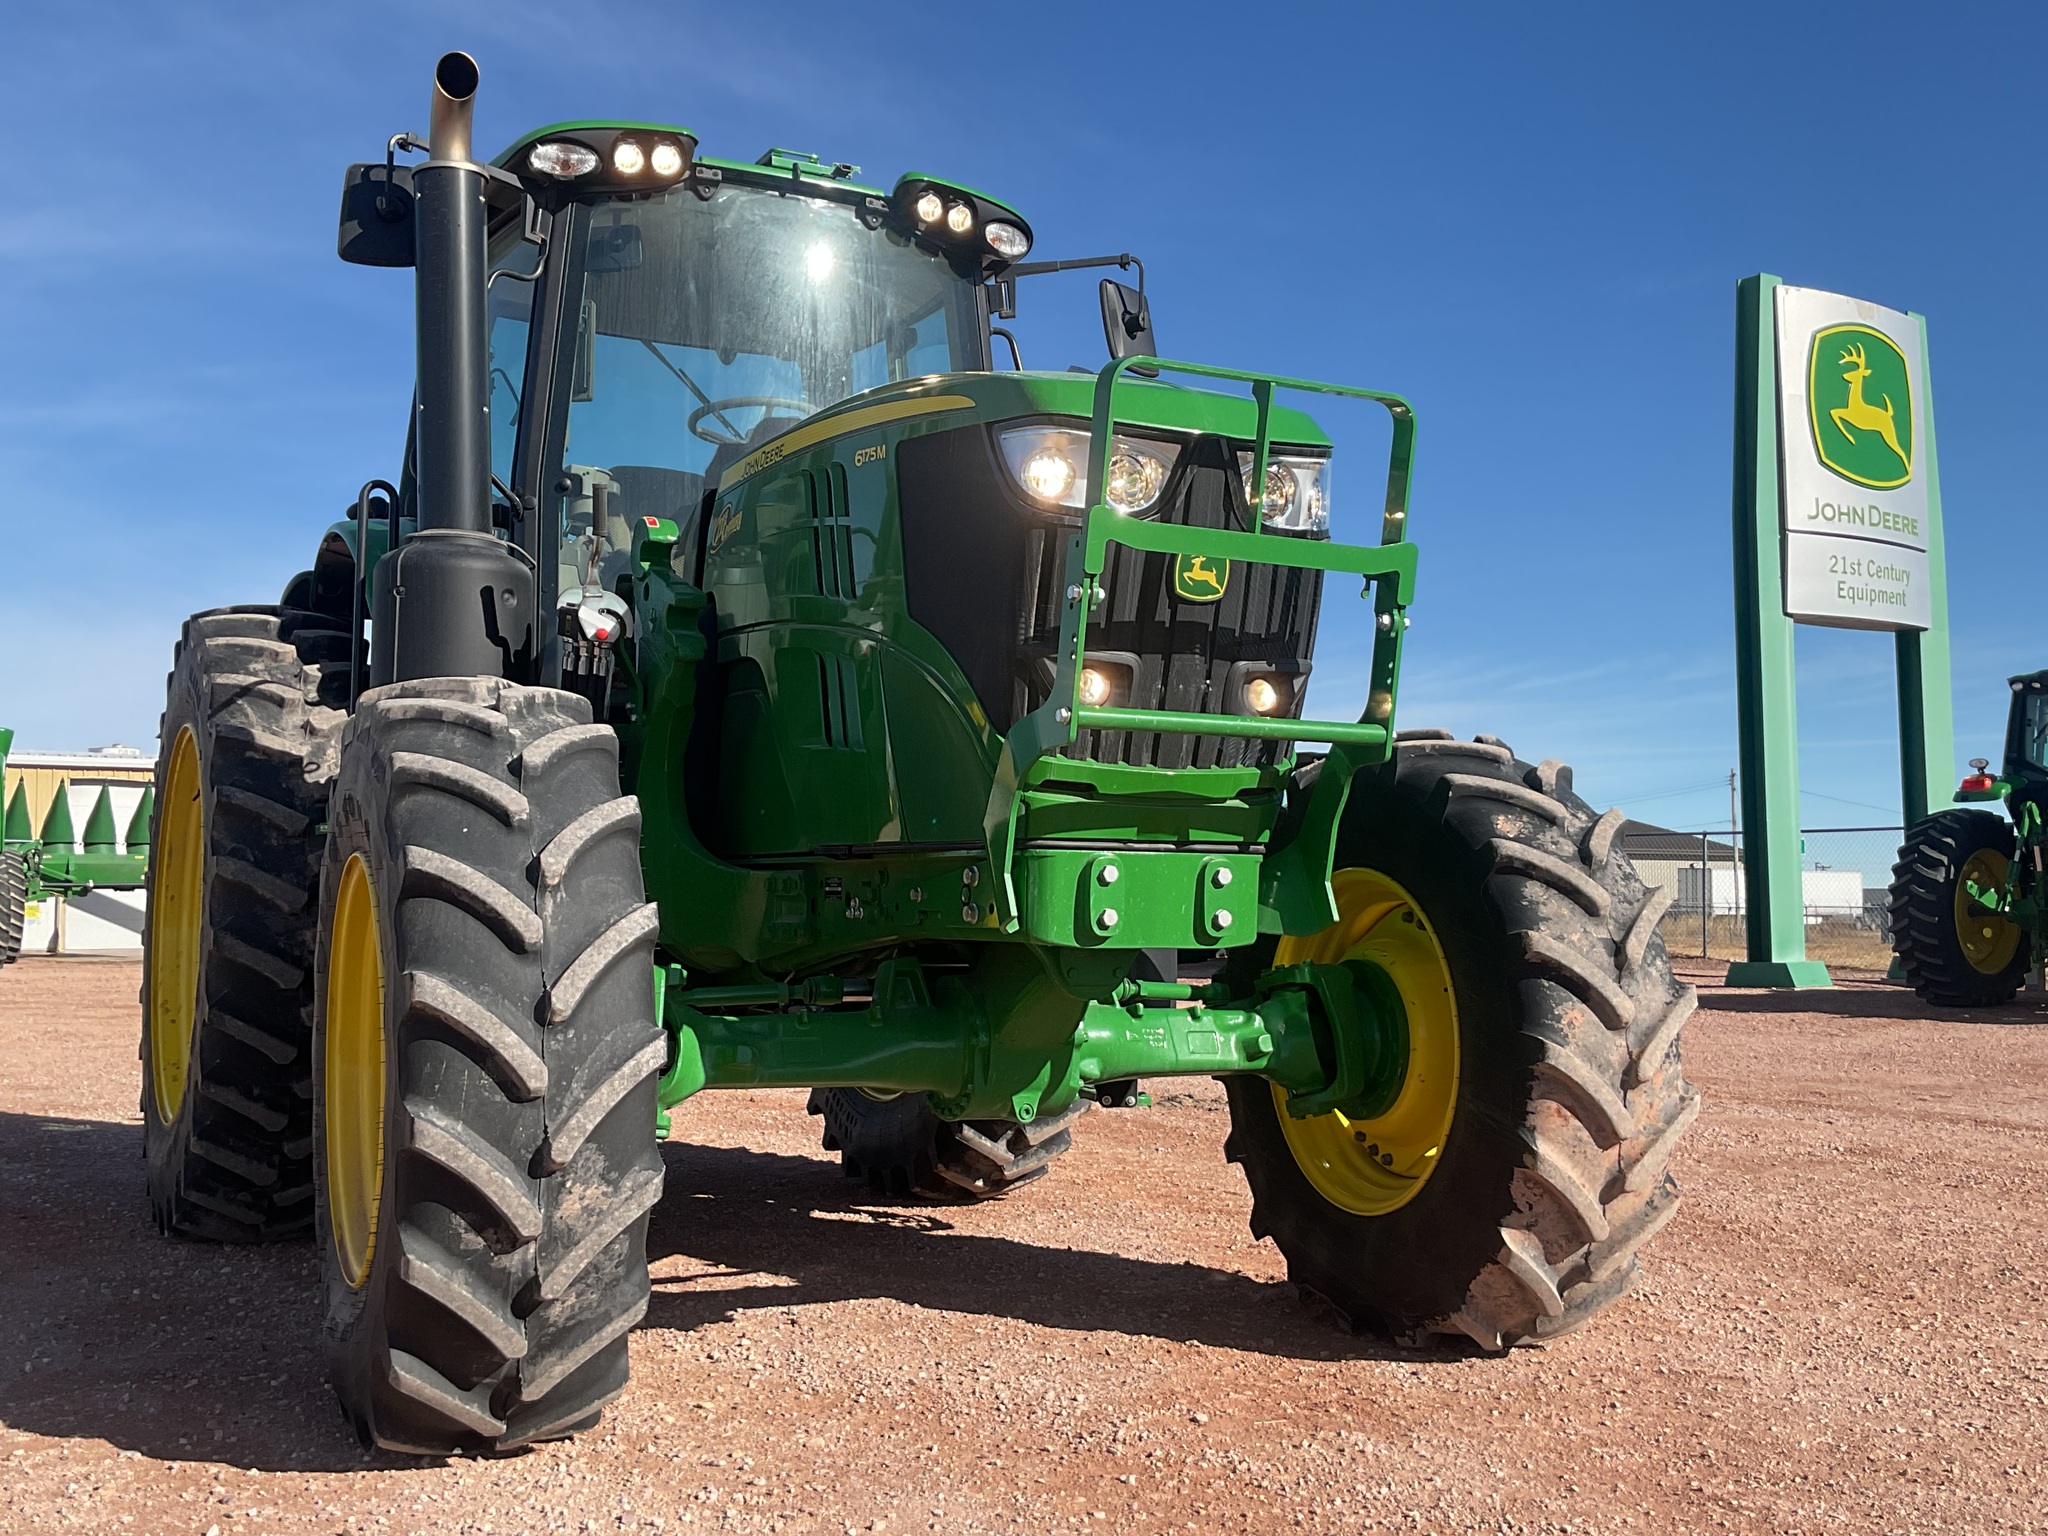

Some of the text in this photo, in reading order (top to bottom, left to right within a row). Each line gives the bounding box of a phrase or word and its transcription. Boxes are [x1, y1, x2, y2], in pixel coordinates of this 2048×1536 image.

[759, 443, 785, 470] DEERE
[854, 444, 887, 468] 6175M
[1807, 497, 1919, 537] JOHN DEERE
[1828, 554, 1910, 587] 21st Century
[1837, 580, 1907, 607] Equipment
